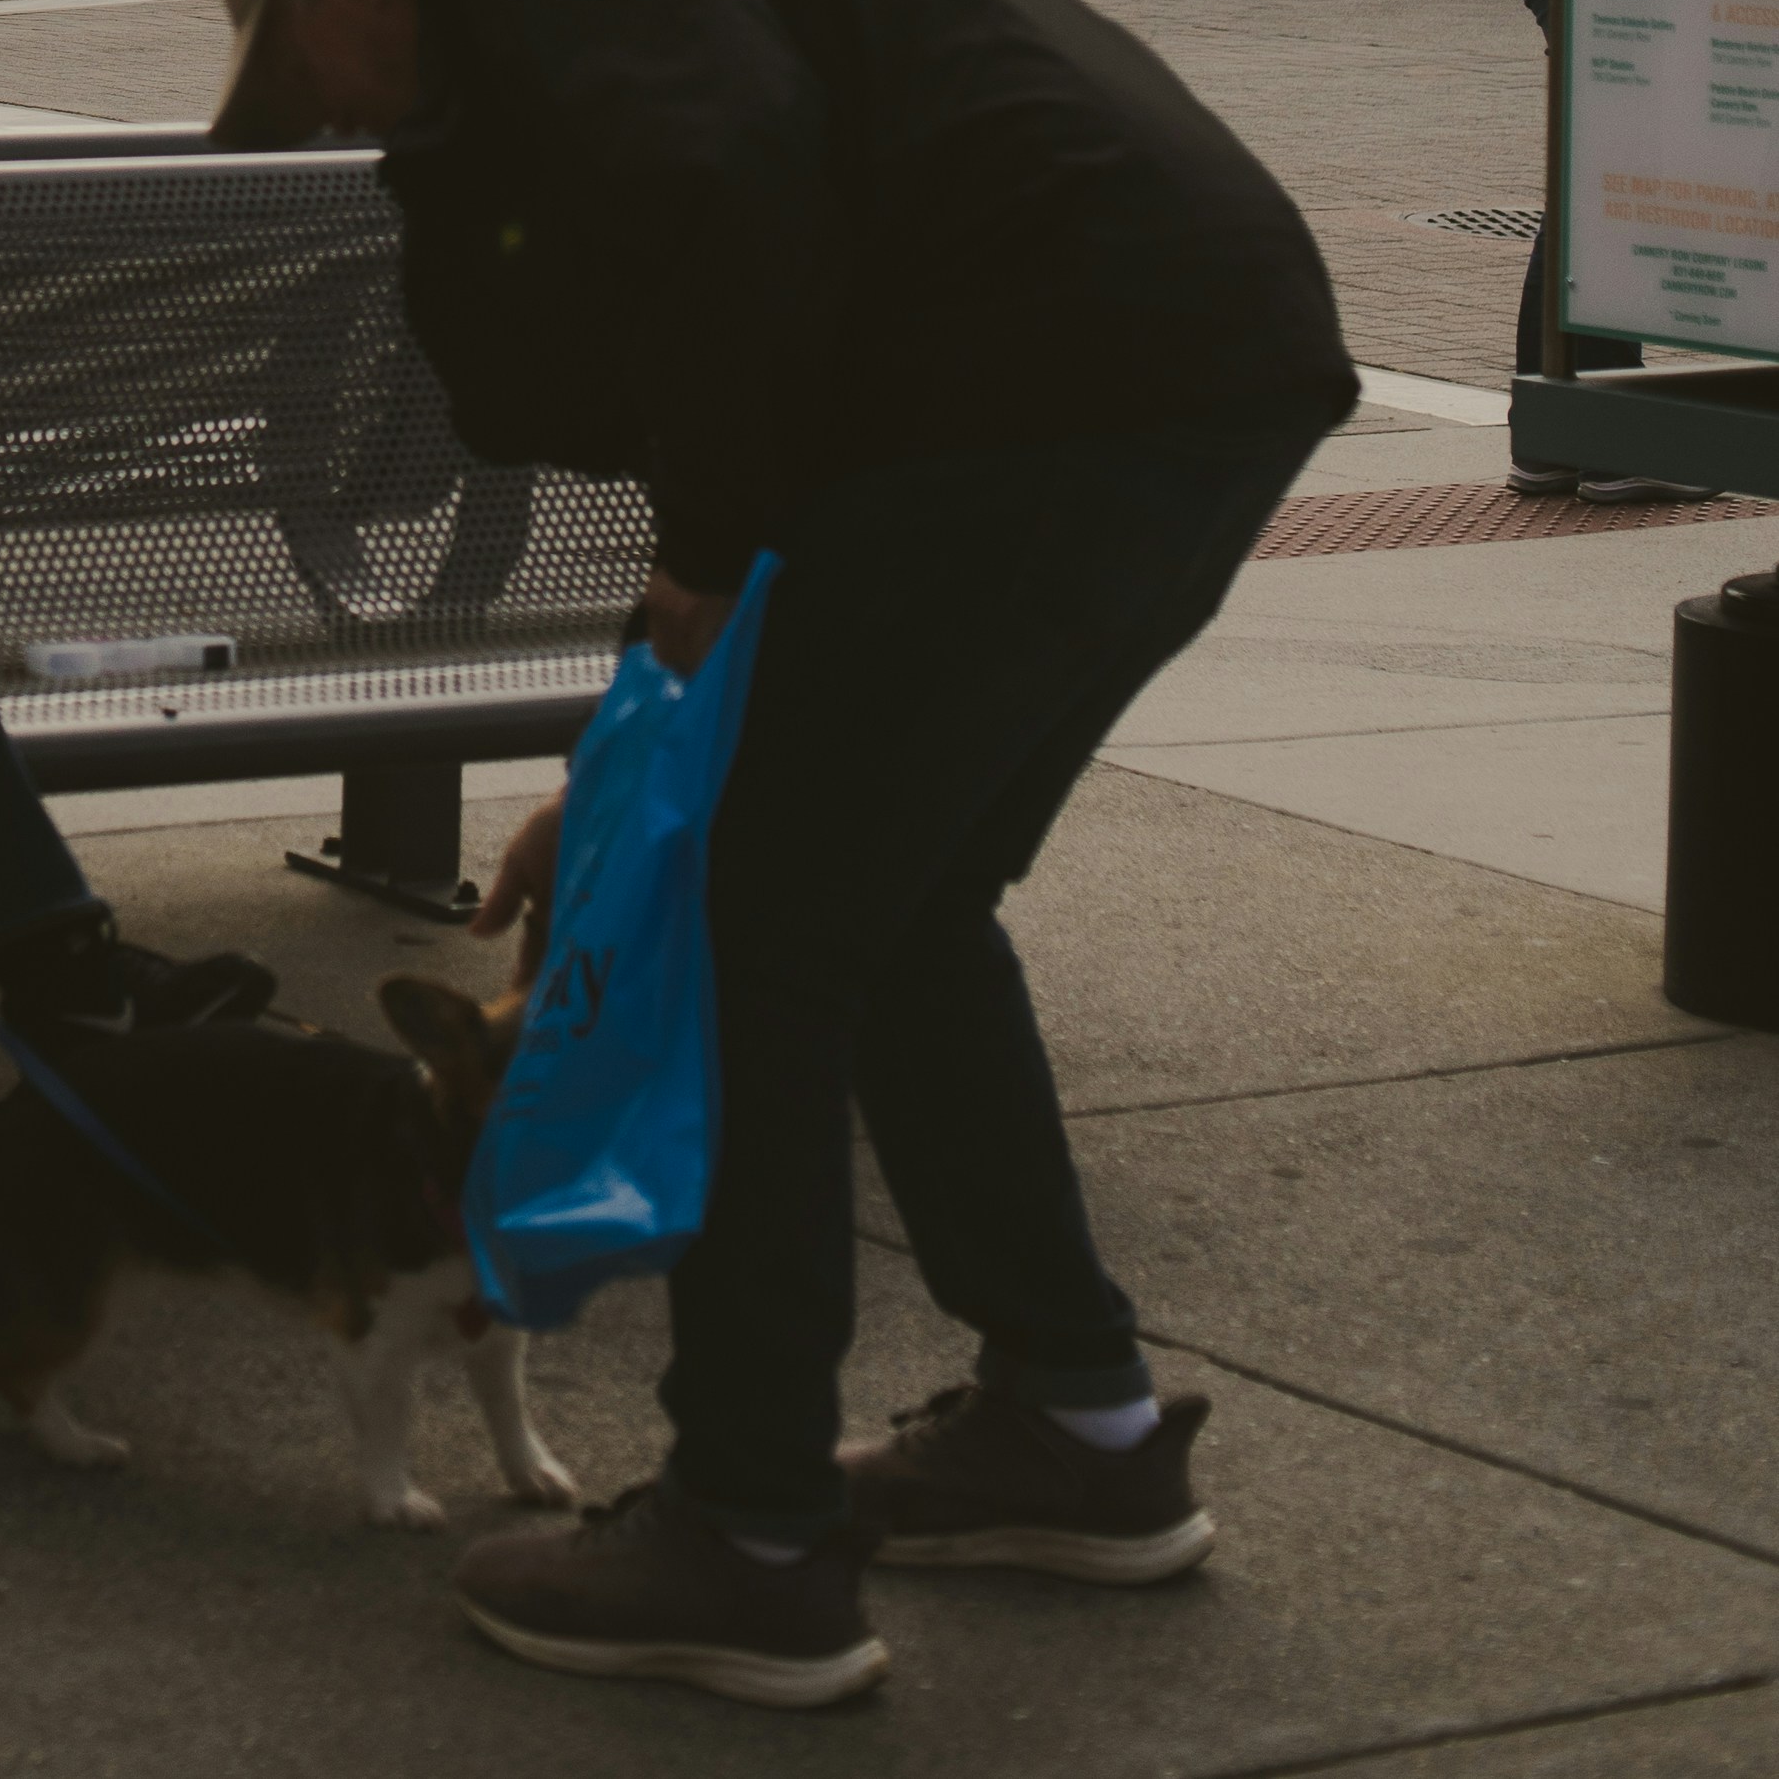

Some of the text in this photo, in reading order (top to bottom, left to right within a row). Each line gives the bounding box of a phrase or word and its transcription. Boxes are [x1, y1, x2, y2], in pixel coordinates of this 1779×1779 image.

[1603, 173, 1627, 193] SEE
[1631, 176, 1662, 197] MAP
[1665, 180, 1693, 200] FOR
[1605, 201, 1632, 220] AND
[1636, 204, 1712, 230] RESTROOM
